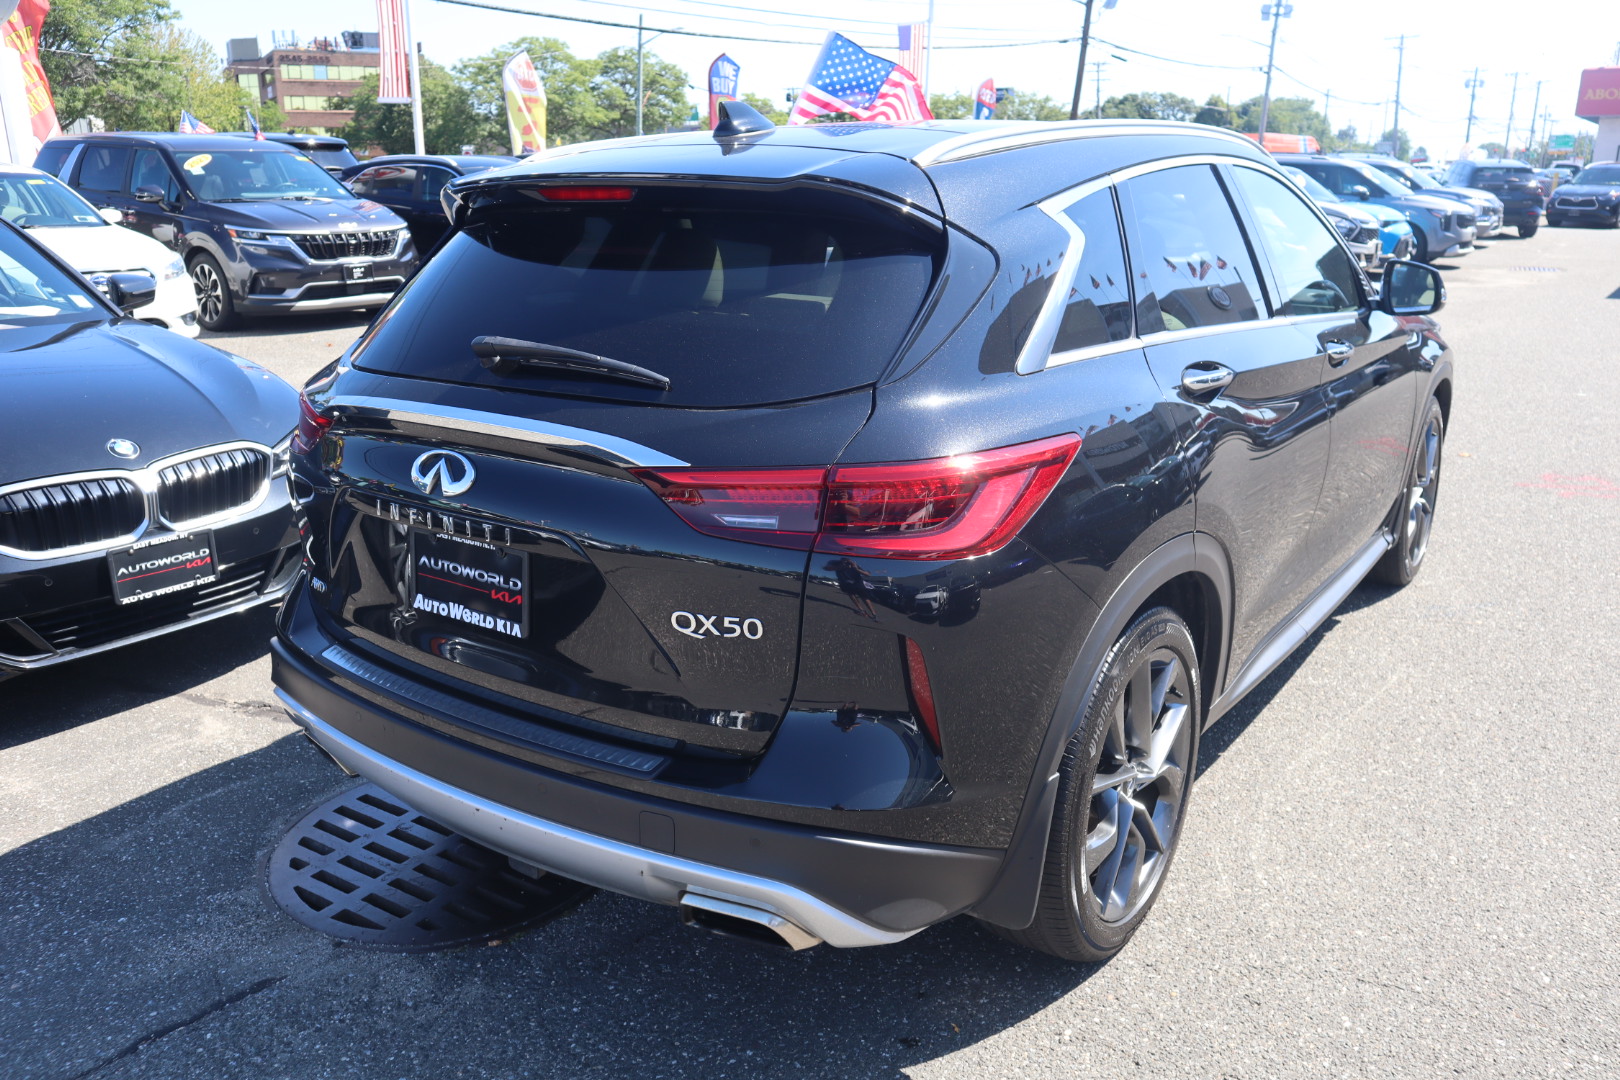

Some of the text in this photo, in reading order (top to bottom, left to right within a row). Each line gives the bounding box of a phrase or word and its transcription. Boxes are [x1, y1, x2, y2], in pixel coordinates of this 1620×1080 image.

[718, 60, 738, 80] WE
[712, 77, 735, 95] BUY
[1584, 87, 1620, 100] ABO
[376, 499, 510, 546] INFINITI
[117, 548, 210, 576] AUTOWORLD
[186, 556, 212, 569] KIA
[418, 555, 522, 591] AUTOWORLD
[120, 575, 216, 605] AUTO WORLD KIA
[491, 589, 522, 605] KIA
[496, 618, 522, 638] KIA
[671, 611, 764, 639] QX50
